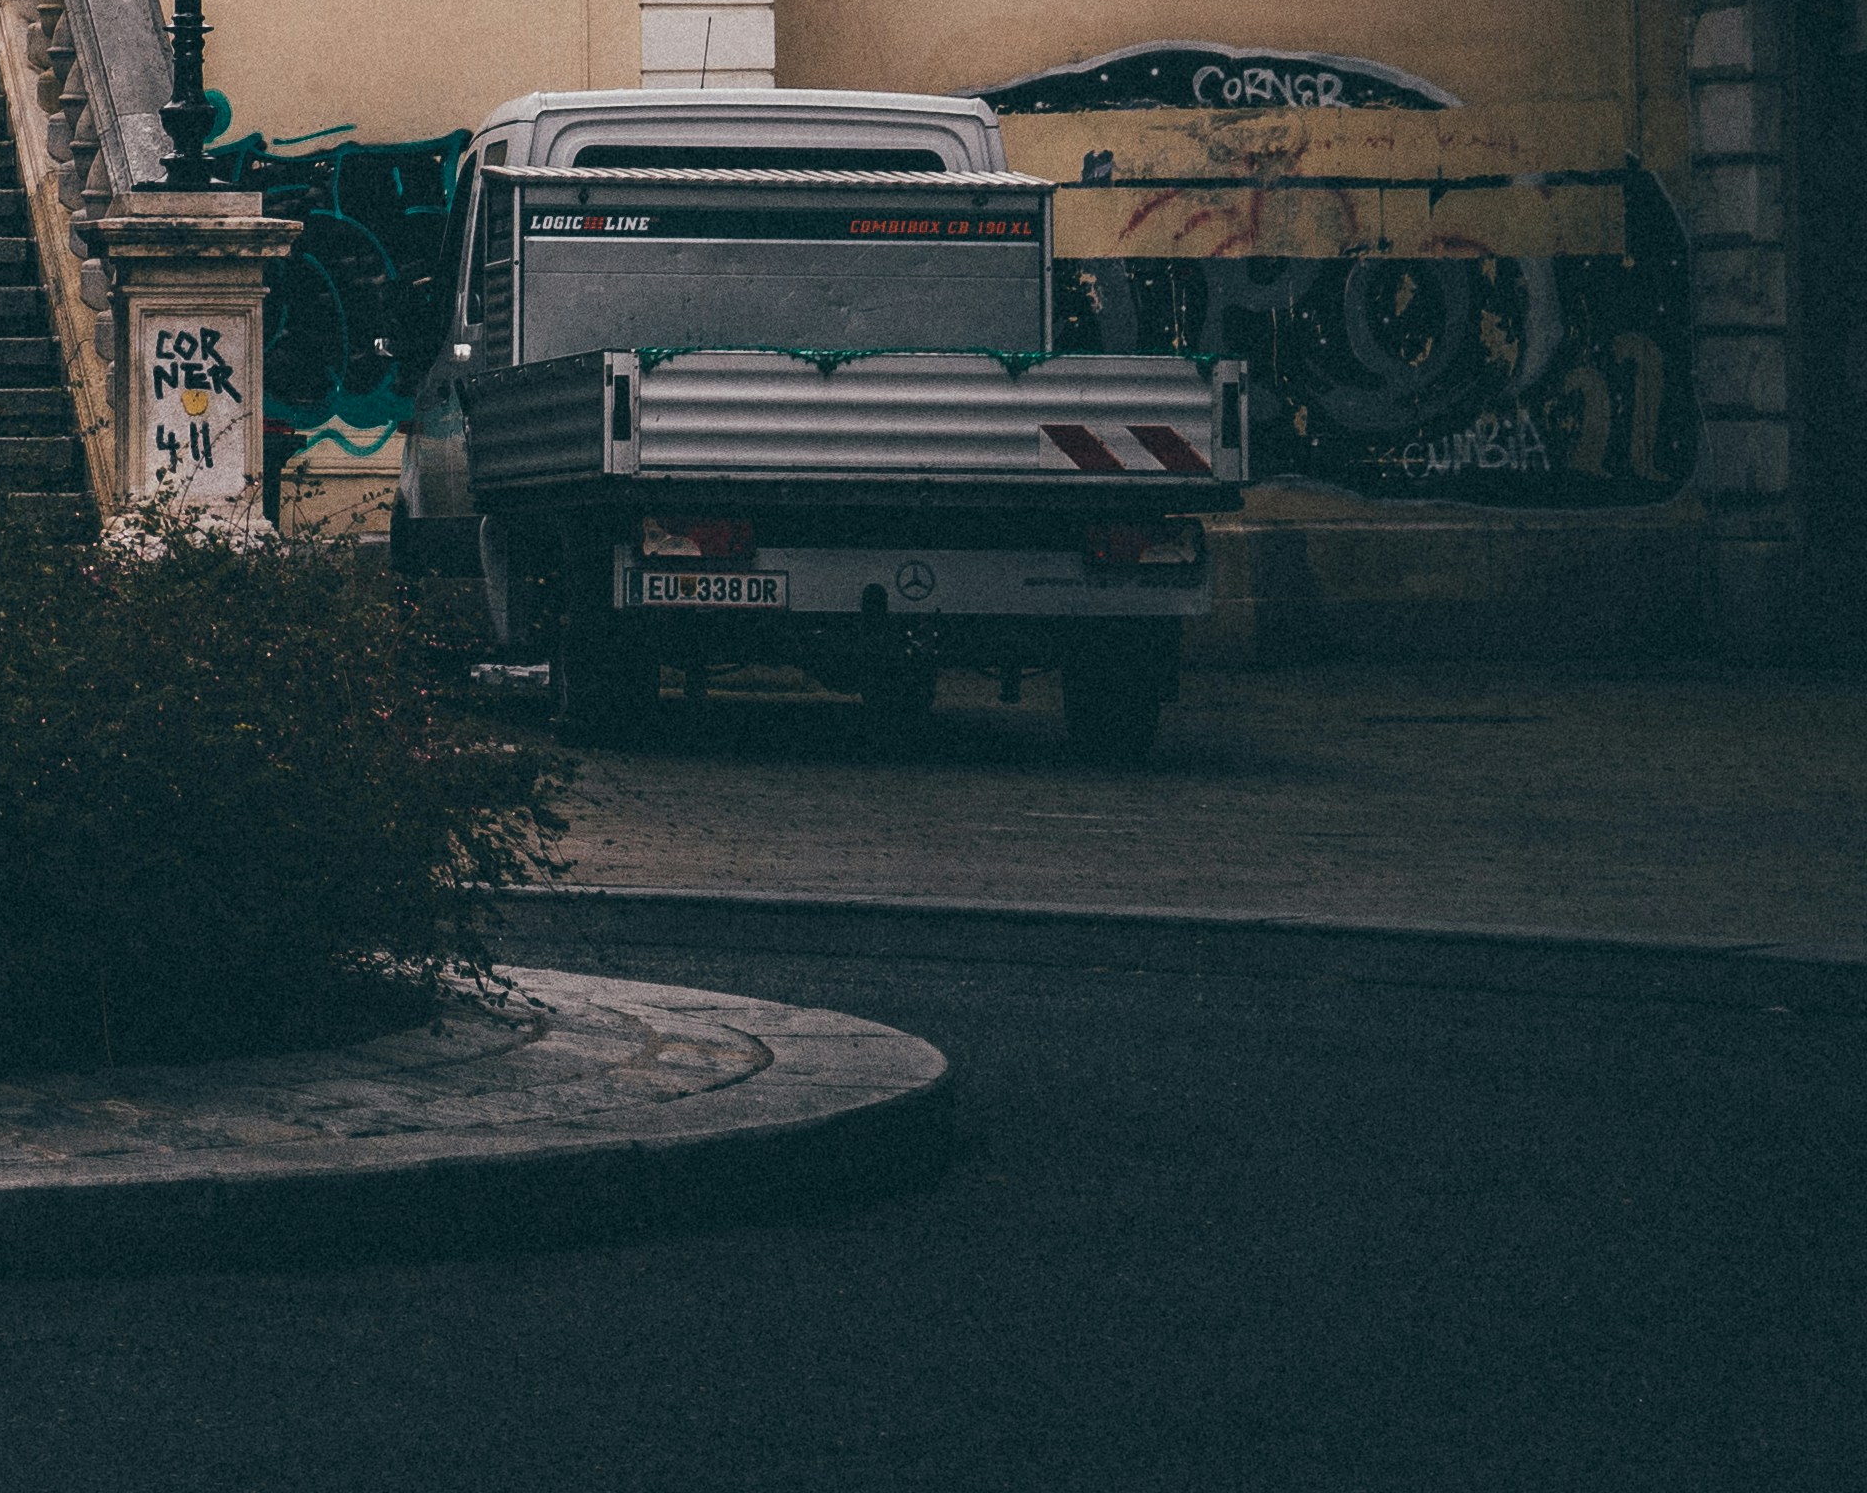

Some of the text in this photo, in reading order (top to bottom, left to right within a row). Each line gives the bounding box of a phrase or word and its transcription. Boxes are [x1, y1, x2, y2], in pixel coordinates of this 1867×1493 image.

[530, 215, 651, 231] LOGIC LINE
[849, 219, 940, 234] COMBIBOX
[947, 220, 970, 235] CB
[1011, 220, 1032, 235] XL
[156, 327, 225, 366] COR
[153, 361, 243, 404] NER
[647, 575, 778, 603] EU 338 DR
